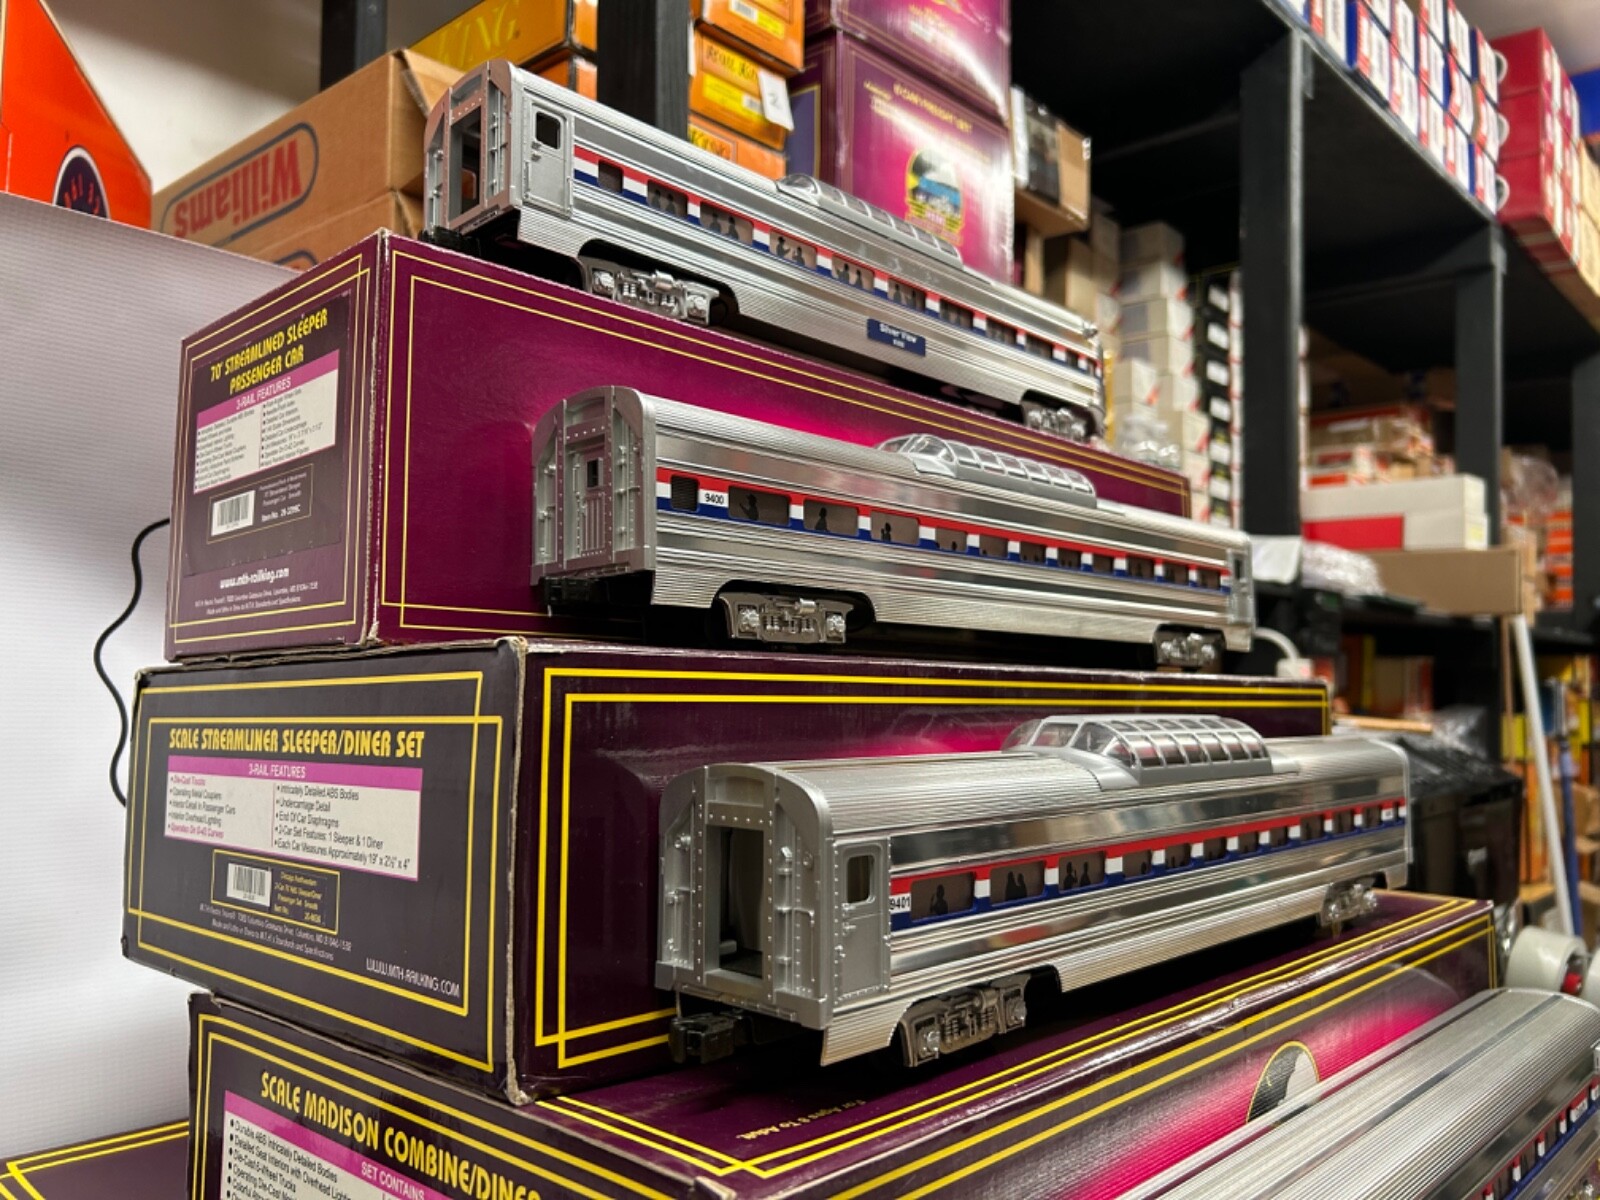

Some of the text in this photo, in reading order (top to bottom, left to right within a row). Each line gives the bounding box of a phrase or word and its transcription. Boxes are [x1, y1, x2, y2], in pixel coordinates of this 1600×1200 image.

[174, 139, 302, 238] Williams
[225, 331, 285, 375] STREAMLINED
[287, 308, 328, 345] SLEEPER
[230, 344, 304, 395] PASSENGER CAR
[257, 376, 291, 400] FEATURES
[705, 493, 725, 505] 9400
[169, 728, 425, 758] SCALE STREAMLINER SLEEPER/DINER SET
[248, 763, 306, 778] 3-RAIL FEATURES
[890, 896, 910, 910] 9401
[261, 1072, 301, 1113] SCALE
[304, 1090, 380, 1151] MADISON
[293, 1151, 317, 1171] Detailed
[317, 1162, 338, 1183] Bodies
[360, 1162, 425, 1200] SET CONTAINS
